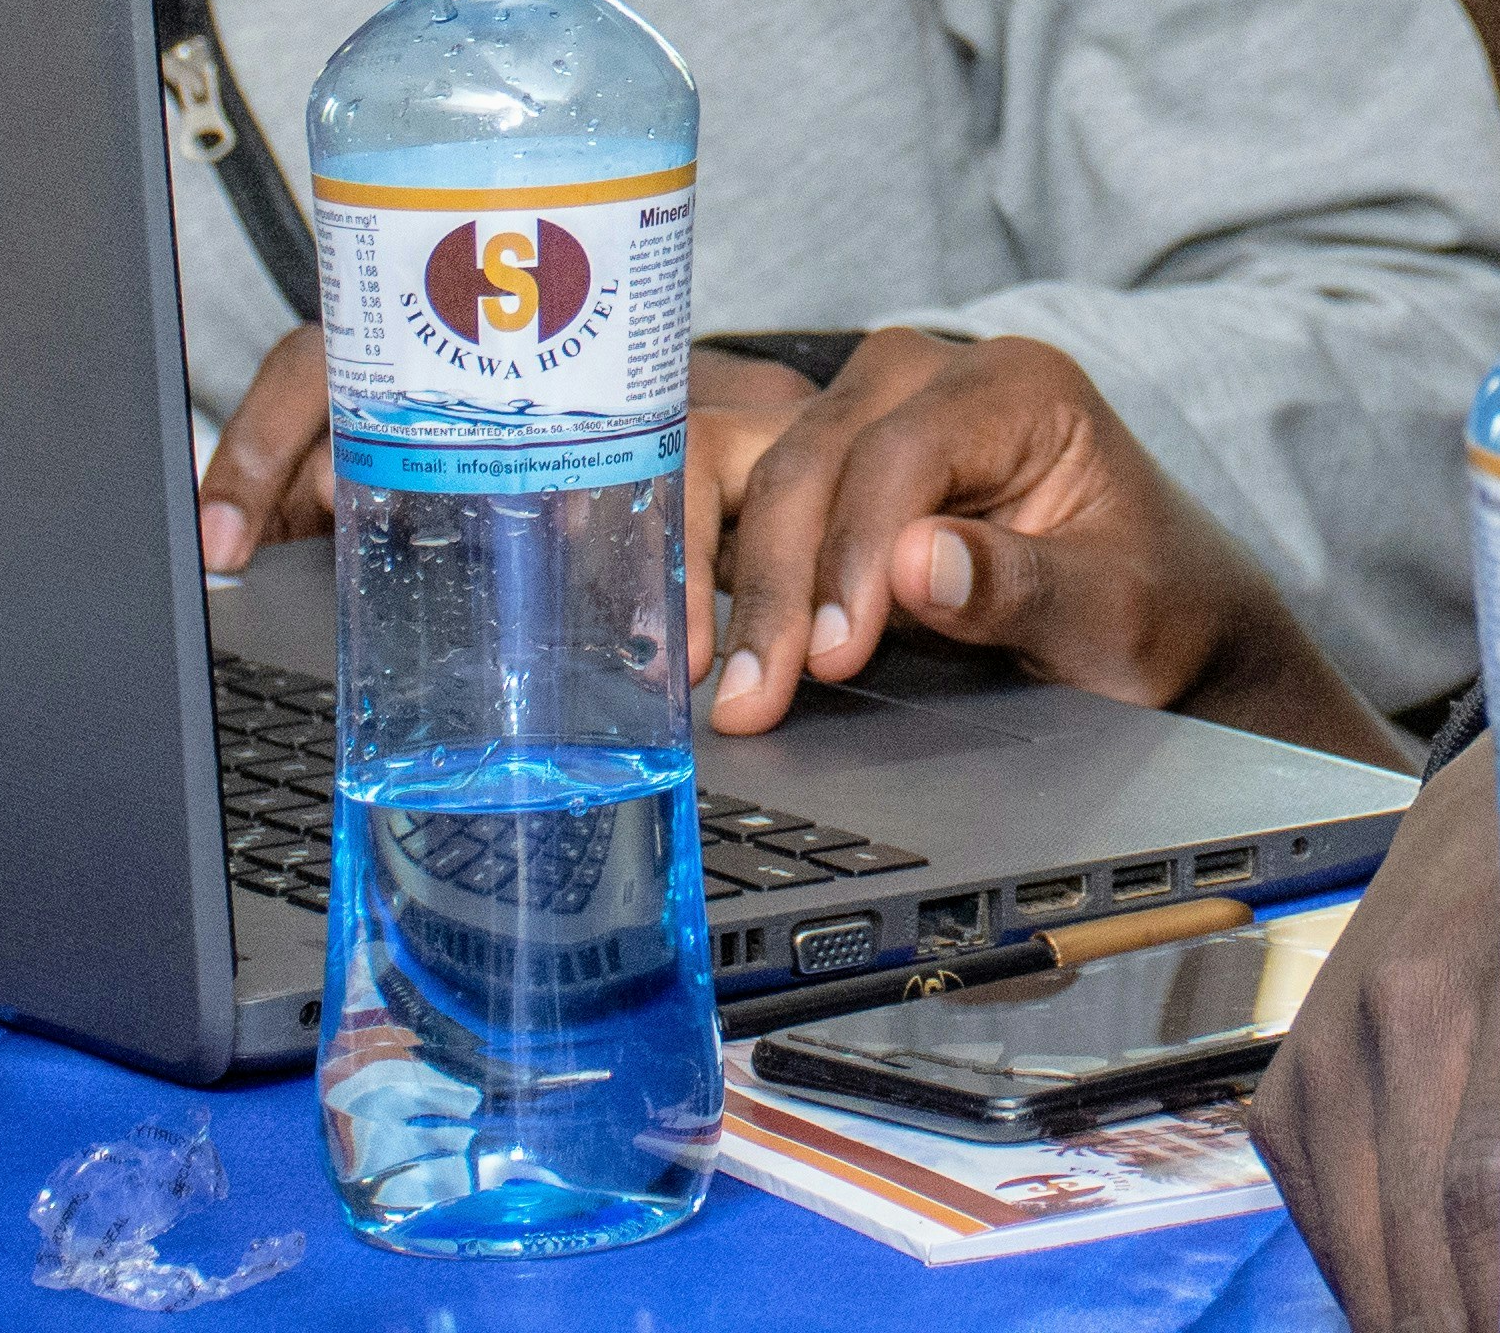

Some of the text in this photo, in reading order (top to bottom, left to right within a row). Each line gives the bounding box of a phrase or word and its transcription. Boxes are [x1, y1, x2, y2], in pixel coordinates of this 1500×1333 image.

[639, 196, 690, 229] Mineral
[356, 233, 375, 246] 14.3
[630, 239, 637, 250] A
[356, 249, 376, 261] 0.17
[358, 264, 378, 277] 1.68
[360, 280, 380, 293] 3.98
[363, 311, 383, 325] 70.3
[364, 327, 385, 340] 2.53
[400, 279, 620, 380] SIRIKWA HOTEL
[365, 343, 381, 356] 6.9
[369, 371, 396, 386] place
[658, 429, 681, 459] 500
[402, 449, 634, 477] Email: info@sirikwahotel.com
